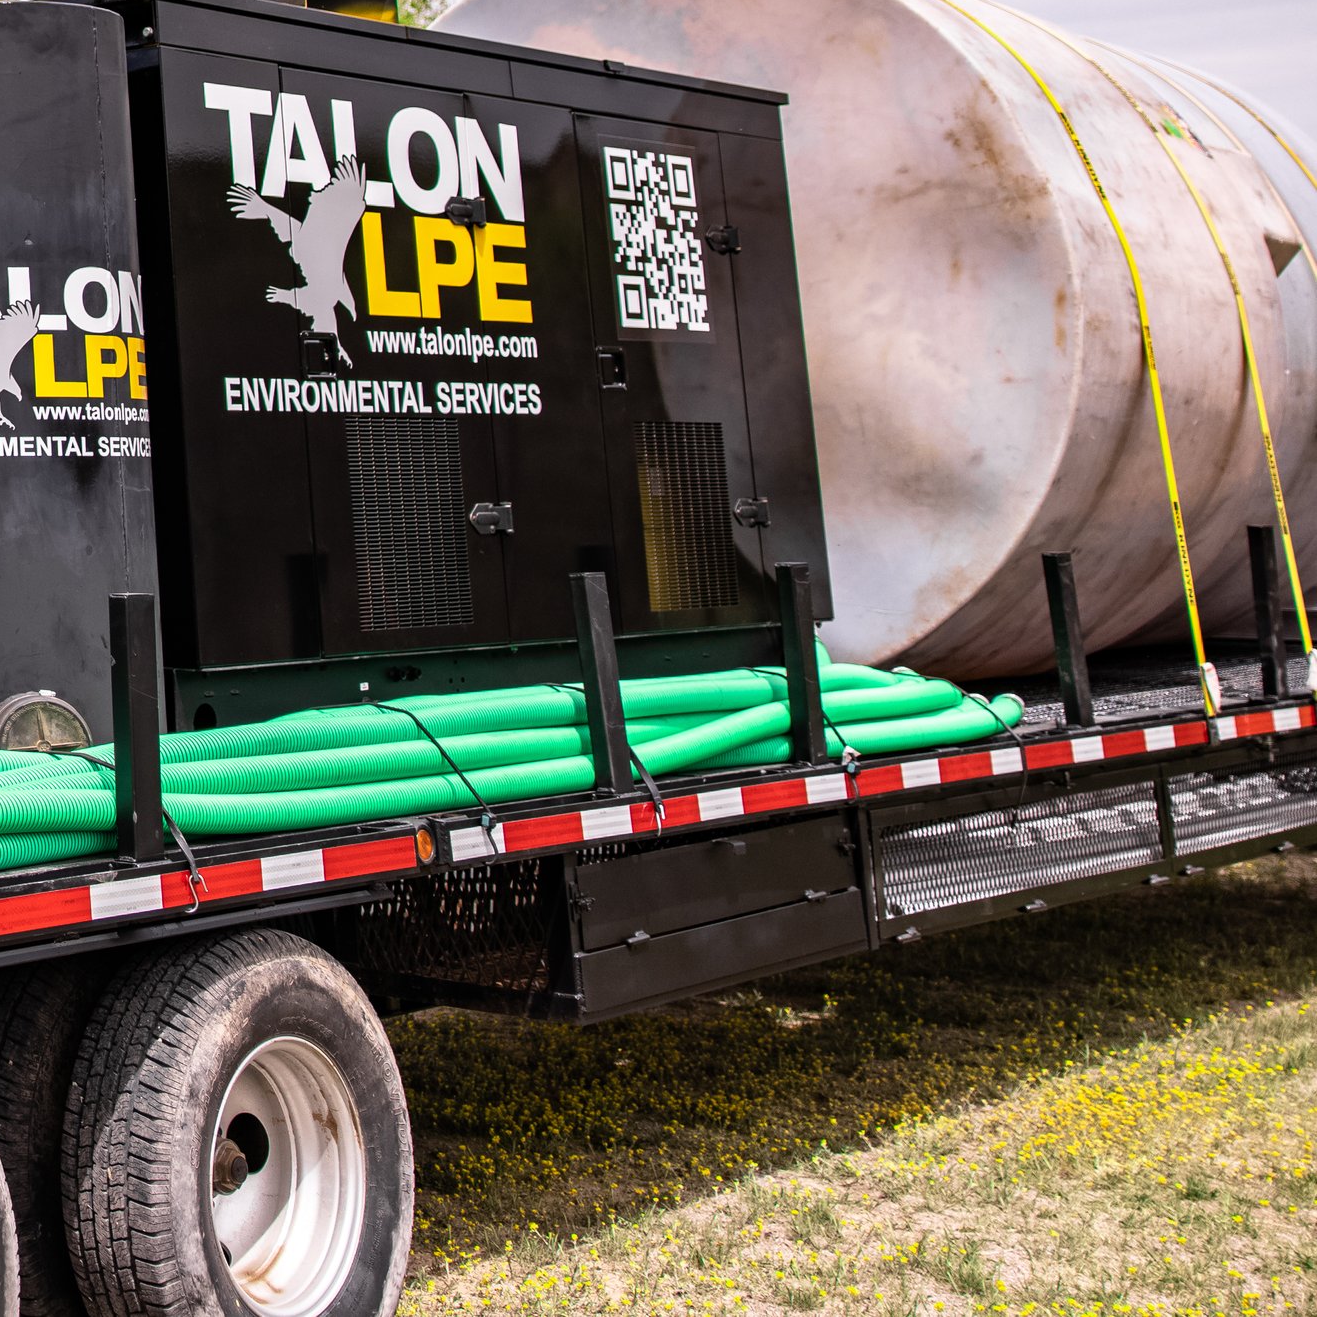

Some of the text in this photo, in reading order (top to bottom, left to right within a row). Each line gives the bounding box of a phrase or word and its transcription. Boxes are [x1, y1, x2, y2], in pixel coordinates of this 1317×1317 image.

[203, 82, 525, 222] TALON
[362, 211, 533, 323] LPE
[33, 333, 148, 400] LPE
[366, 326, 538, 363] www.talonlpe.com
[224, 377, 542, 415] ENVIRONMENTAL SERVICES
